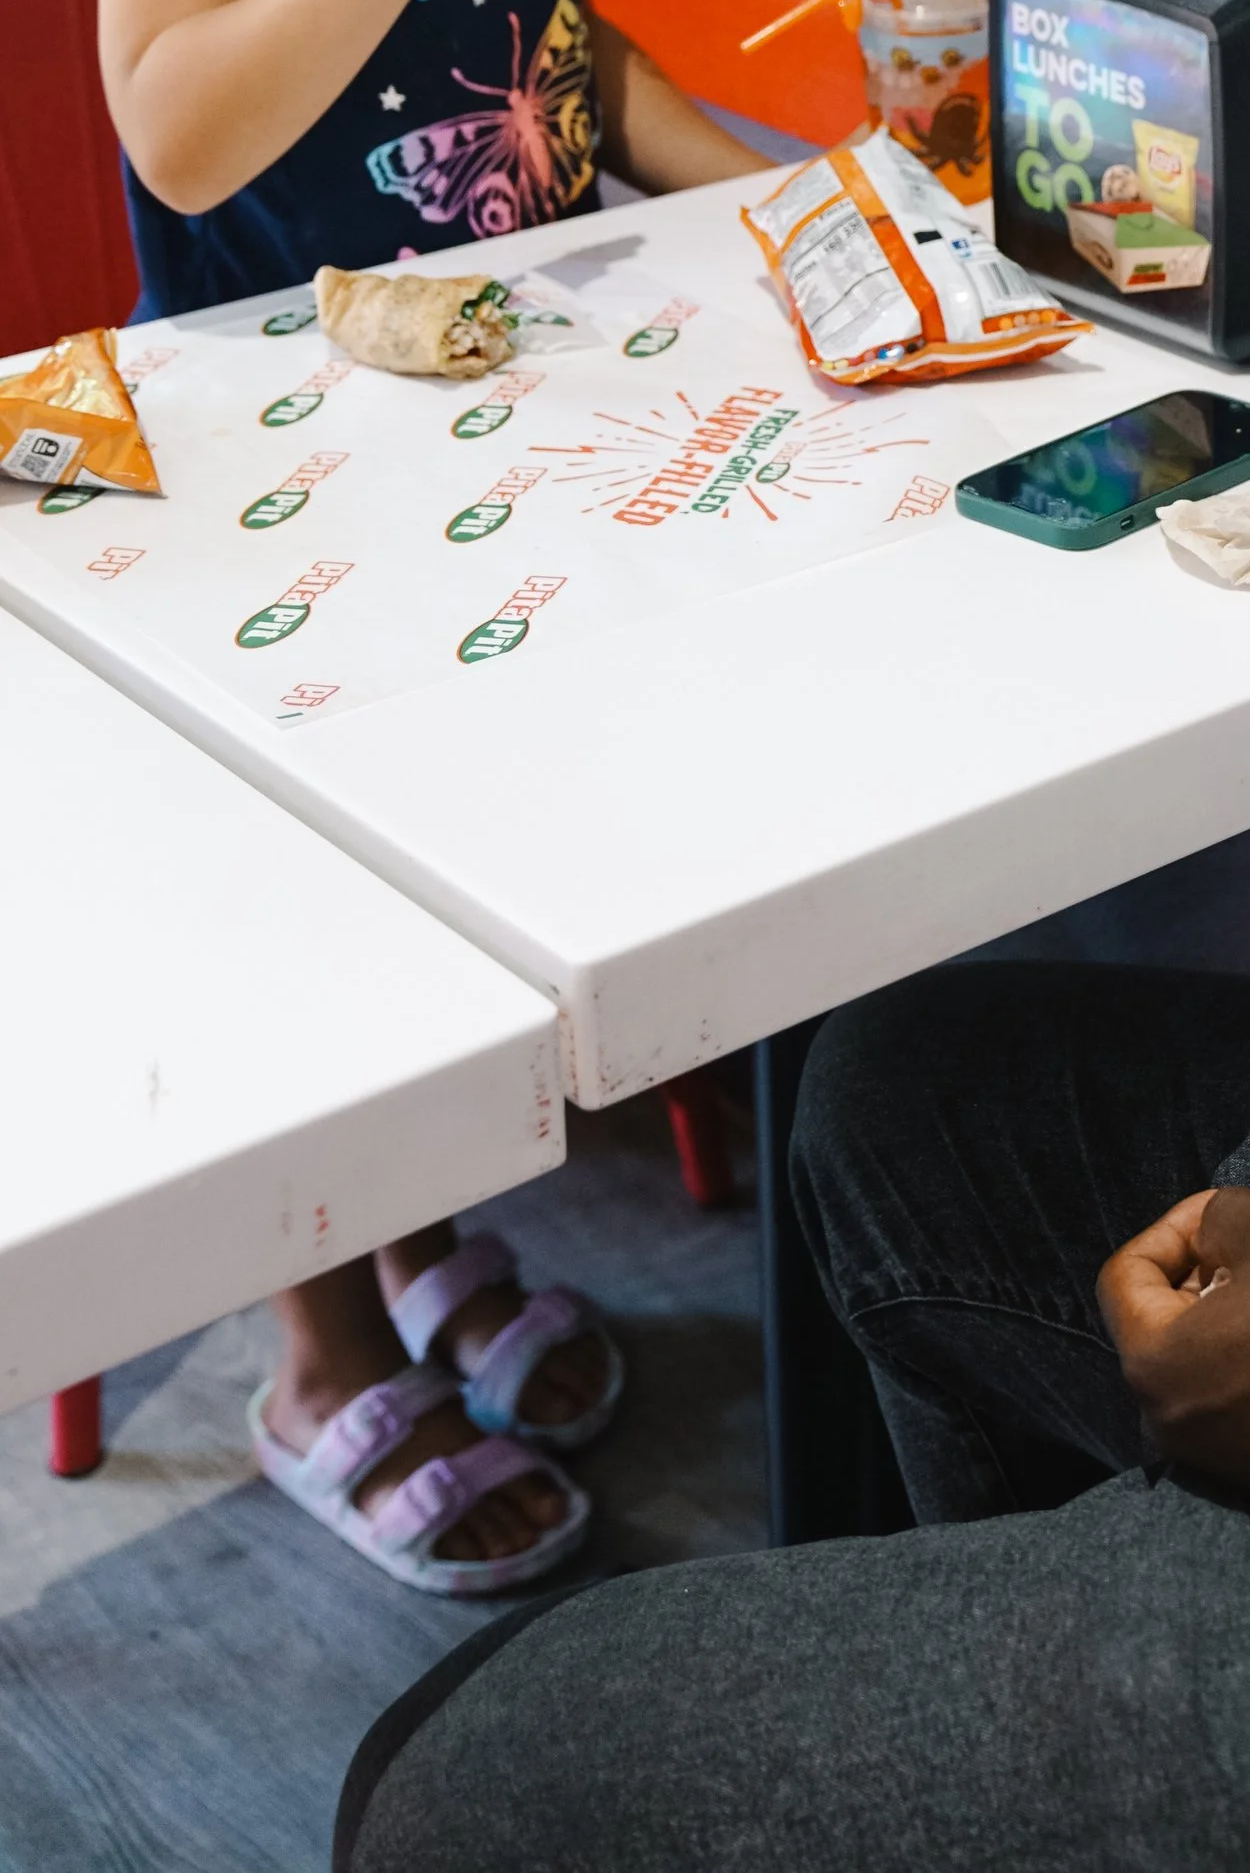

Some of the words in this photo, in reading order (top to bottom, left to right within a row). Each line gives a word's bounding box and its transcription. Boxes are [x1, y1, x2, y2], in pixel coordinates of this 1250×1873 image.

[1011, 1, 1070, 49] BOX
[1013, 40, 1146, 110] LUNCHES
[1015, 83, 1094, 163] TO
[1016, 148, 1095, 217] GO
[612, 386, 784, 526] FLAVOR-FILLED
